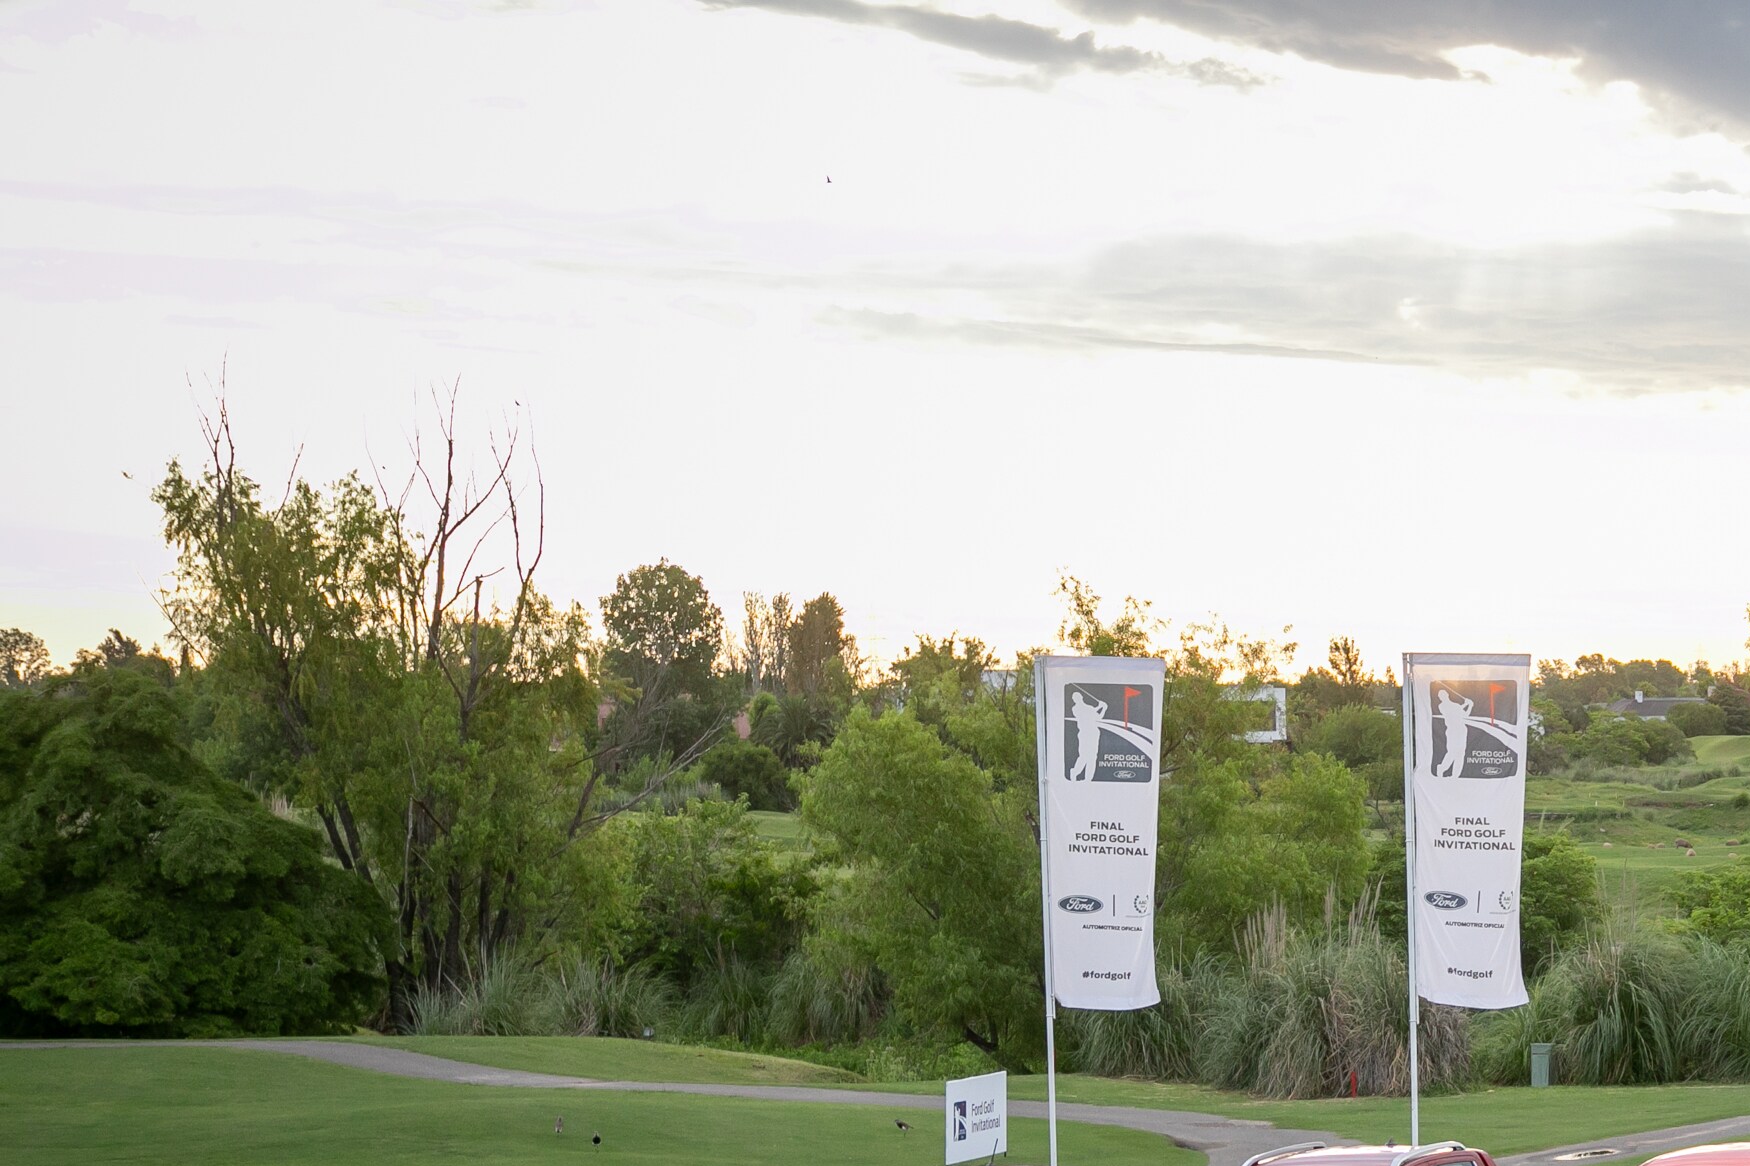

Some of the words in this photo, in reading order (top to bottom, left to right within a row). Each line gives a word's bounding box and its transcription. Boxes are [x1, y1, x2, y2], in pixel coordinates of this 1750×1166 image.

[1090, 821, 1124, 831] FINAL
[1455, 817, 1490, 826] FINAL
[1075, 833, 1107, 842] FORD
[1108, 834, 1140, 843] GOLF
[1441, 828, 1472, 838] FORD
[1474, 829, 1506, 838] GOLF
[1068, 844, 1149, 856] INVITATIONAL
[1434, 839, 1516, 851] INVITATIONAL
[1065, 897, 1096, 911] Ford
[1430, 893, 1460, 908] Ford
[1082, 970, 1131, 981] #fordgolf
[1447, 967, 1493, 980] #fordgolf
[971, 1102, 983, 1116] Ford
[984, 1099, 995, 1114] Golf
[971, 1114, 1000, 1133] Invitational
